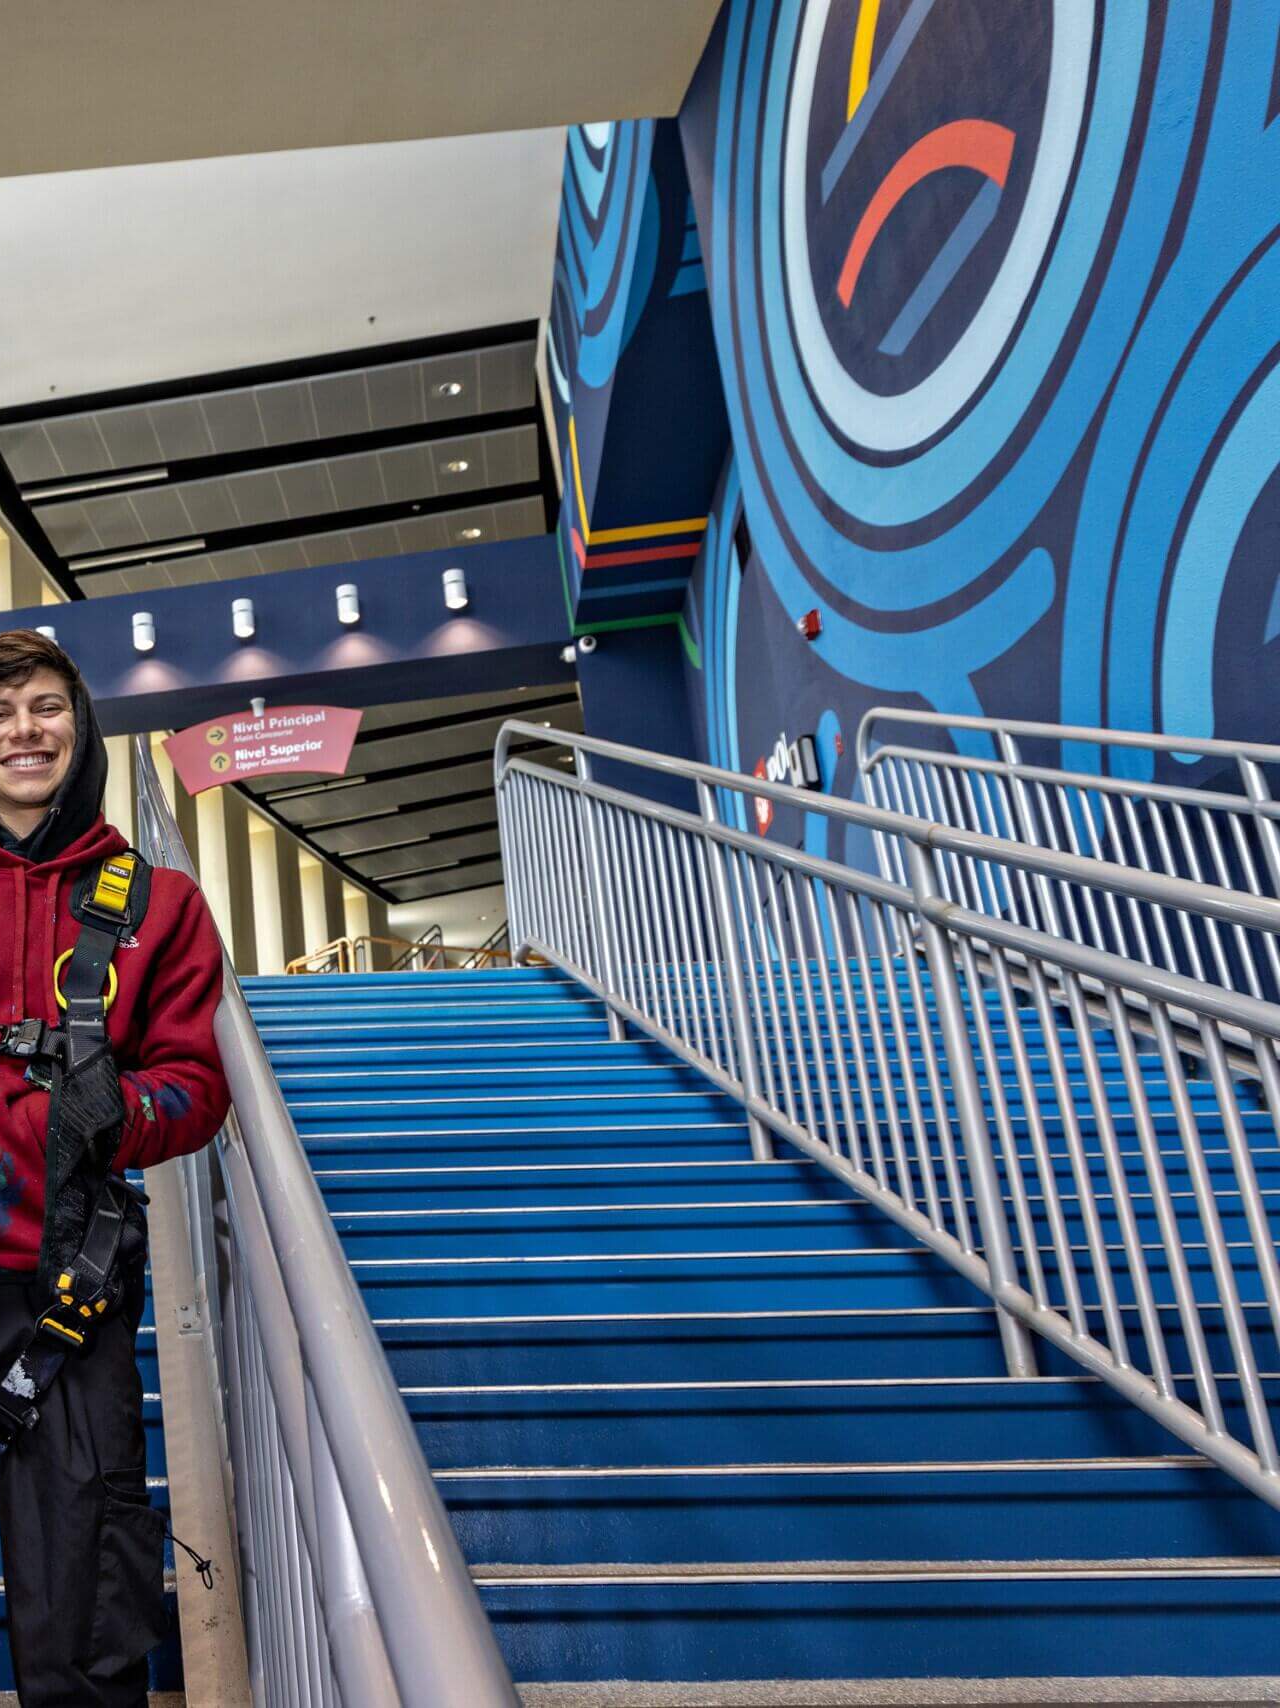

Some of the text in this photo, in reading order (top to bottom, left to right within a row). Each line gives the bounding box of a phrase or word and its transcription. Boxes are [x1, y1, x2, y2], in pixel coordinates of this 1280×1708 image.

[233, 711, 325, 734] Nivel Principal
[255, 729, 293, 740] Concourse
[235, 740, 323, 761] Nivel Superior
[236, 756, 300, 770] Upper Concourse
